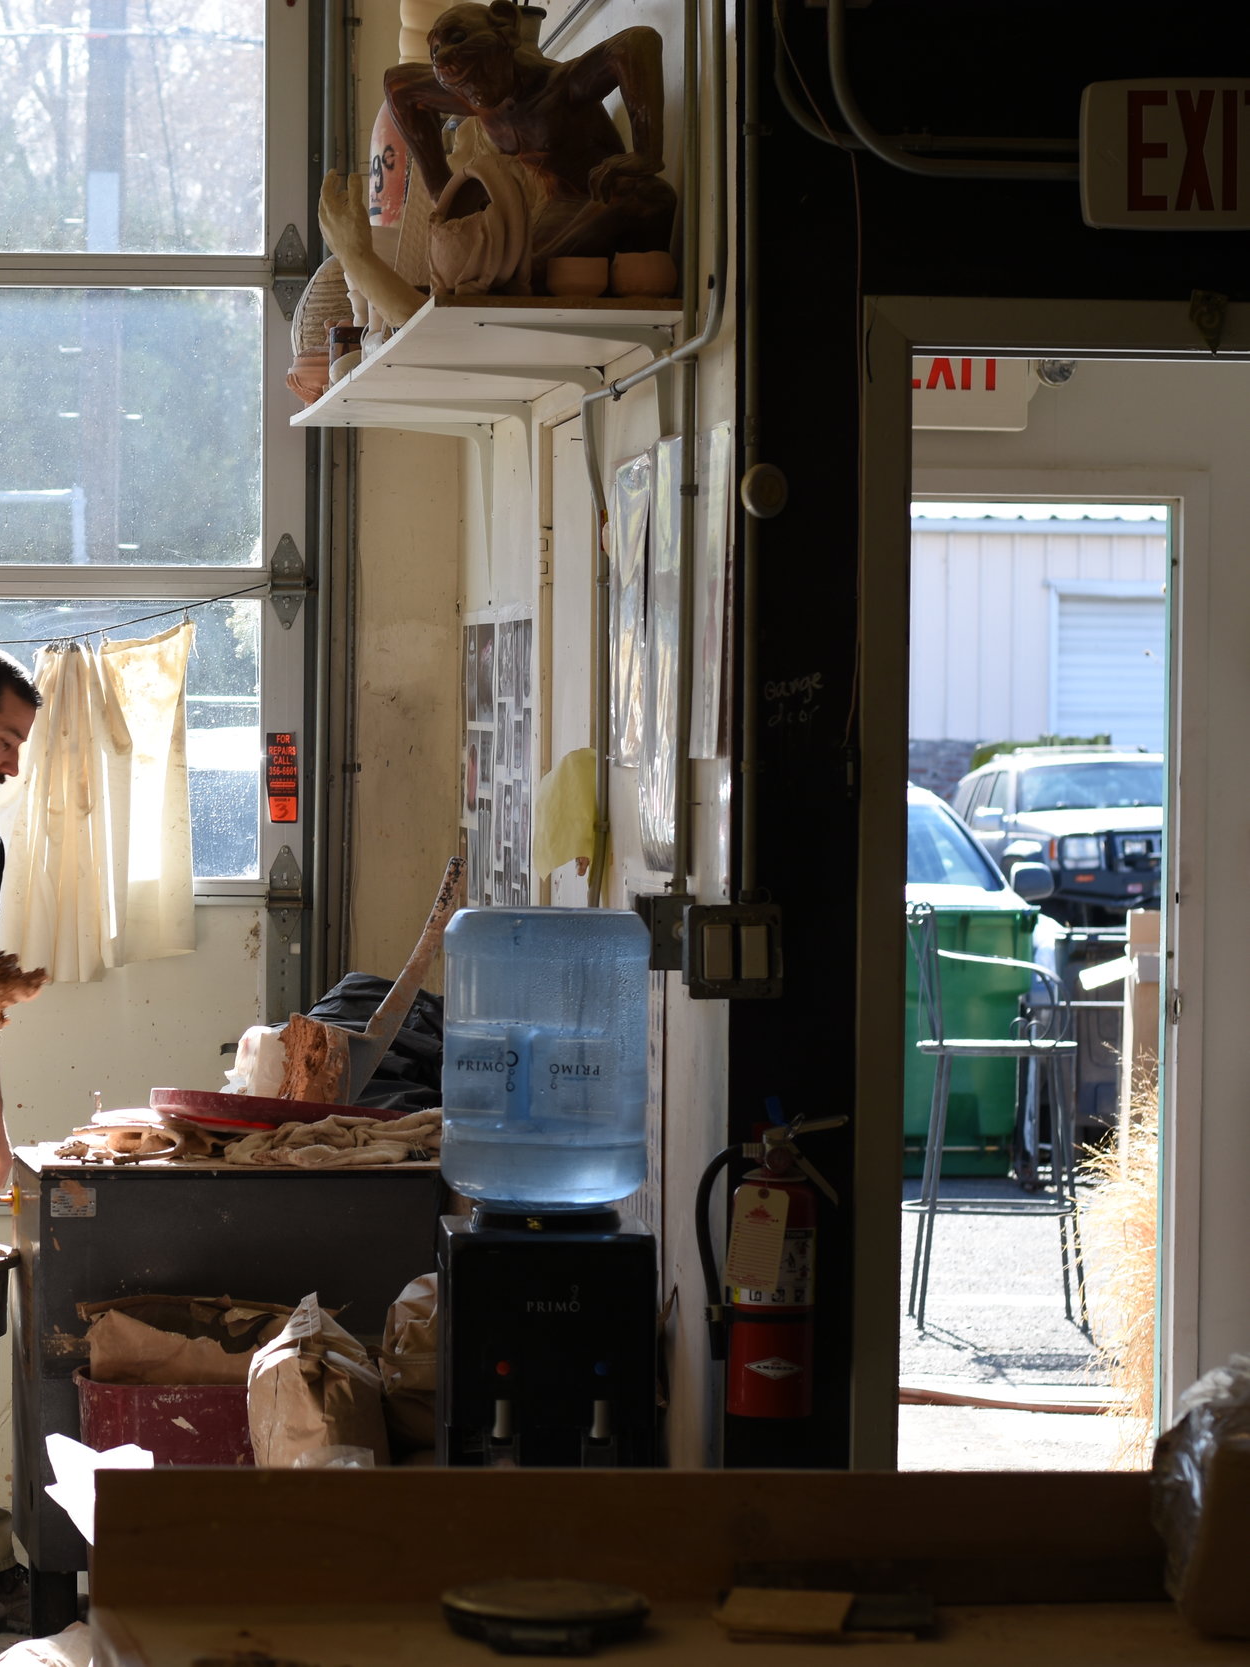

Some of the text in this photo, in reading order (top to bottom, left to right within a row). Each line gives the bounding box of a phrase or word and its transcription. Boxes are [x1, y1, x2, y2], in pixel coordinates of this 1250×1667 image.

[1127, 90, 1250, 211] EXI
[276, 734, 290, 744] FOR
[268, 746, 297, 756] REPAIRS
[273, 755, 293, 765] CALL:
[275, 803, 289, 818] 3
[457, 1059, 505, 1073] PRIMO
[550, 1063, 600, 1076] PRIMO
[526, 1300, 581, 1312] PRIMO
